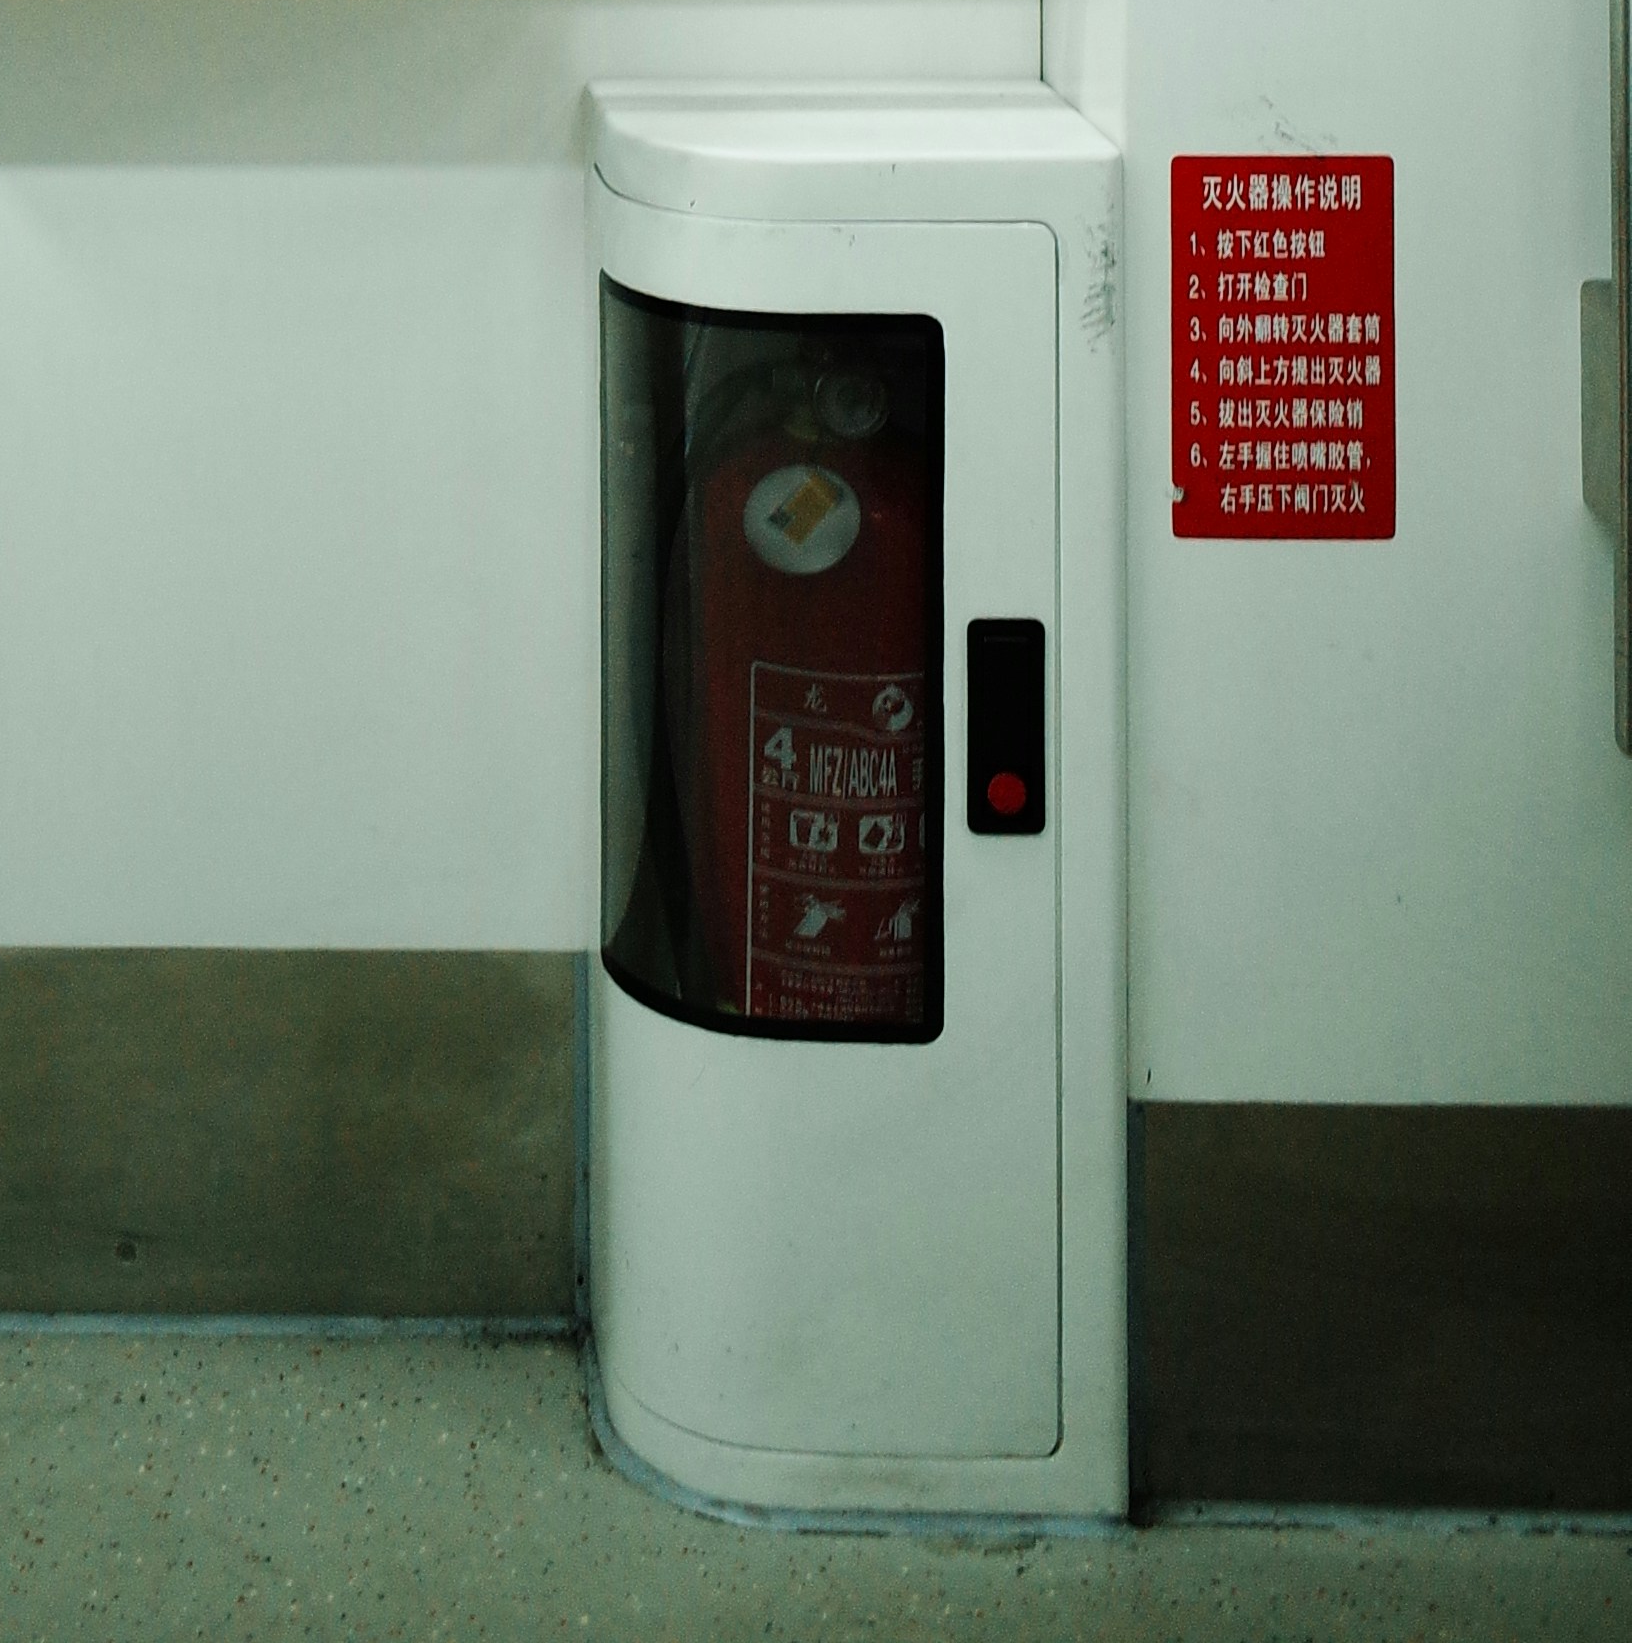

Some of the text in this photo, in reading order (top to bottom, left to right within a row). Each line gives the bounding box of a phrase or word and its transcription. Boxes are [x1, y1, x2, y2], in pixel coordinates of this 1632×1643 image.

[1202, 173, 1363, 212] 灭火器操作说明
[1220, 483, 1366, 514] 右手压下阀门灭火
[809, 742, 899, 800] MFZ/ABC4A
